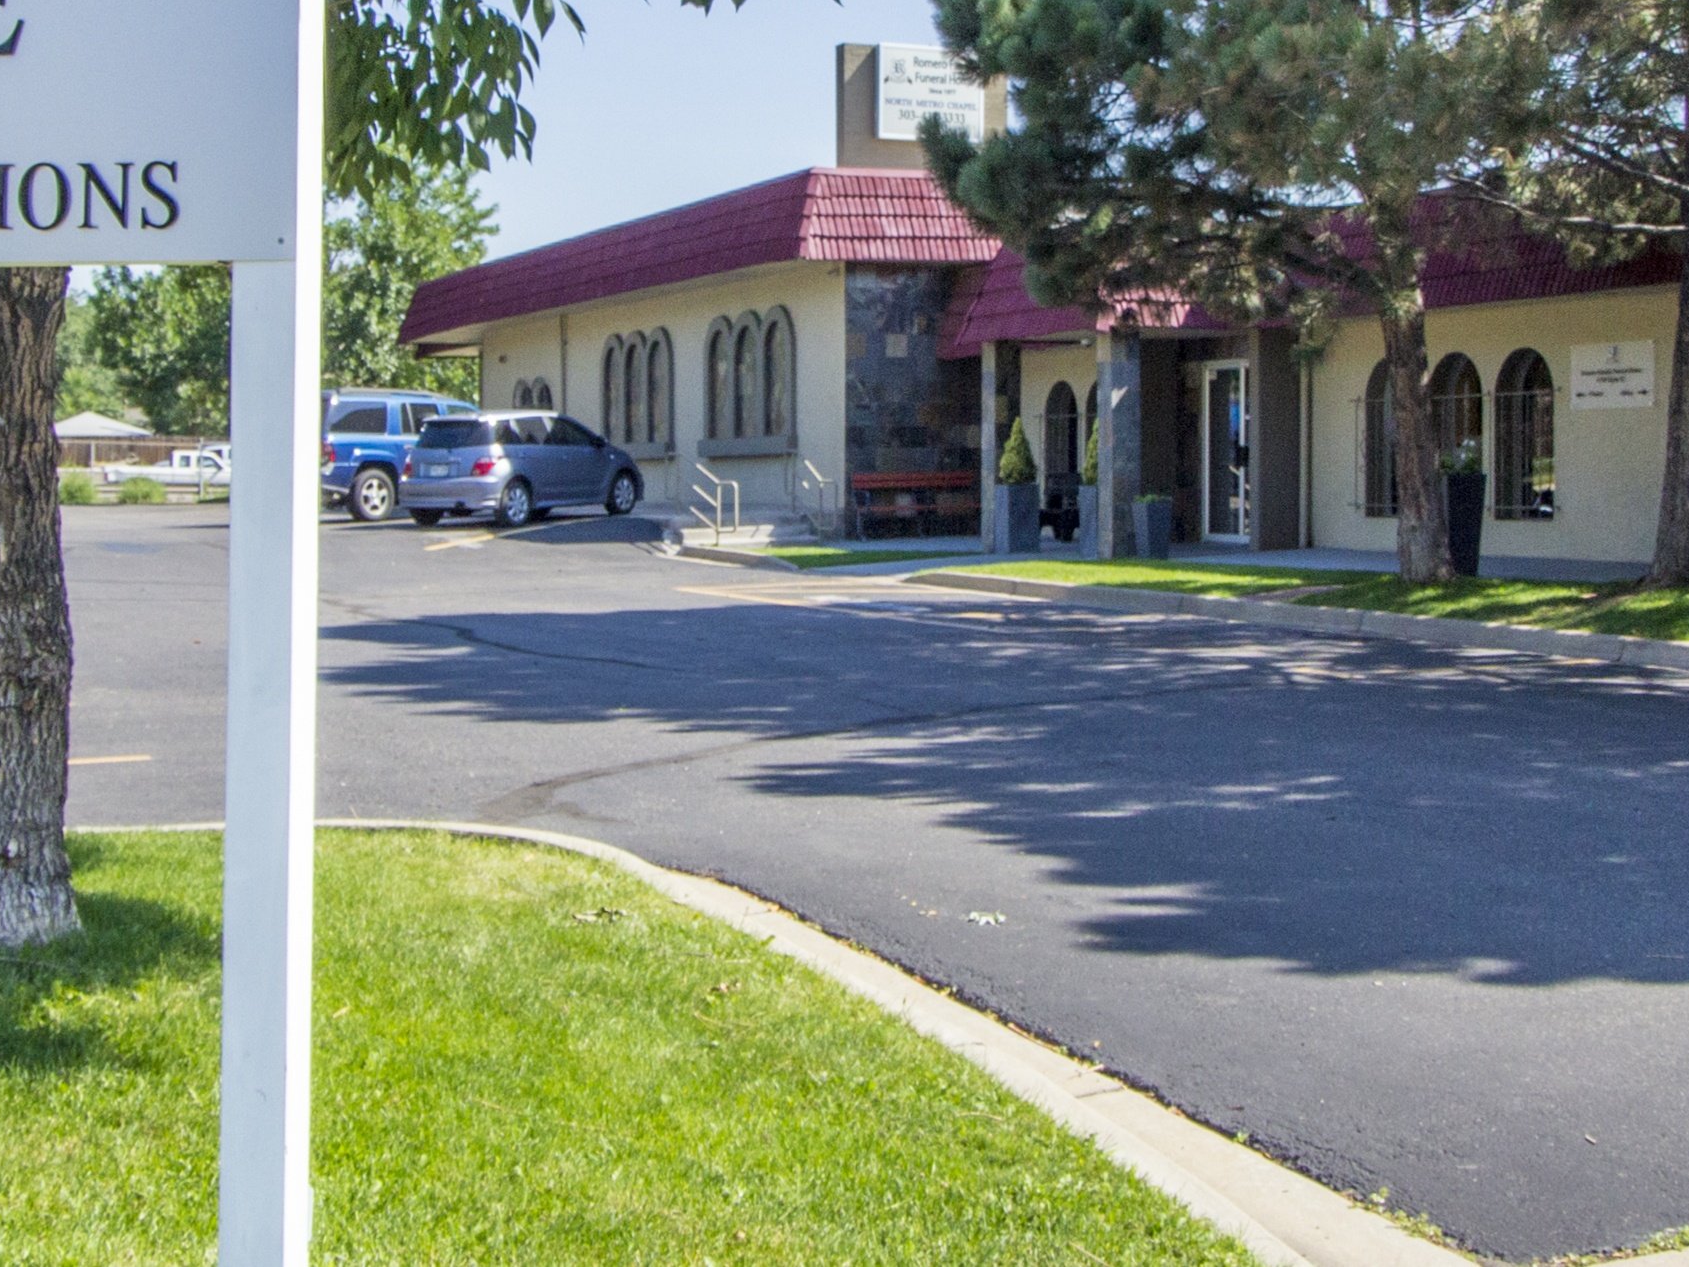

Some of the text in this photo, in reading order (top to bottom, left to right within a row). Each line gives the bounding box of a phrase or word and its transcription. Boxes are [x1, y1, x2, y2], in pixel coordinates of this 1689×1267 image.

[913, 56, 948, 69] Romero
[915, 72, 947, 84] Funeral
[885, 98, 977, 111] NORTH METRO CHAPEL
